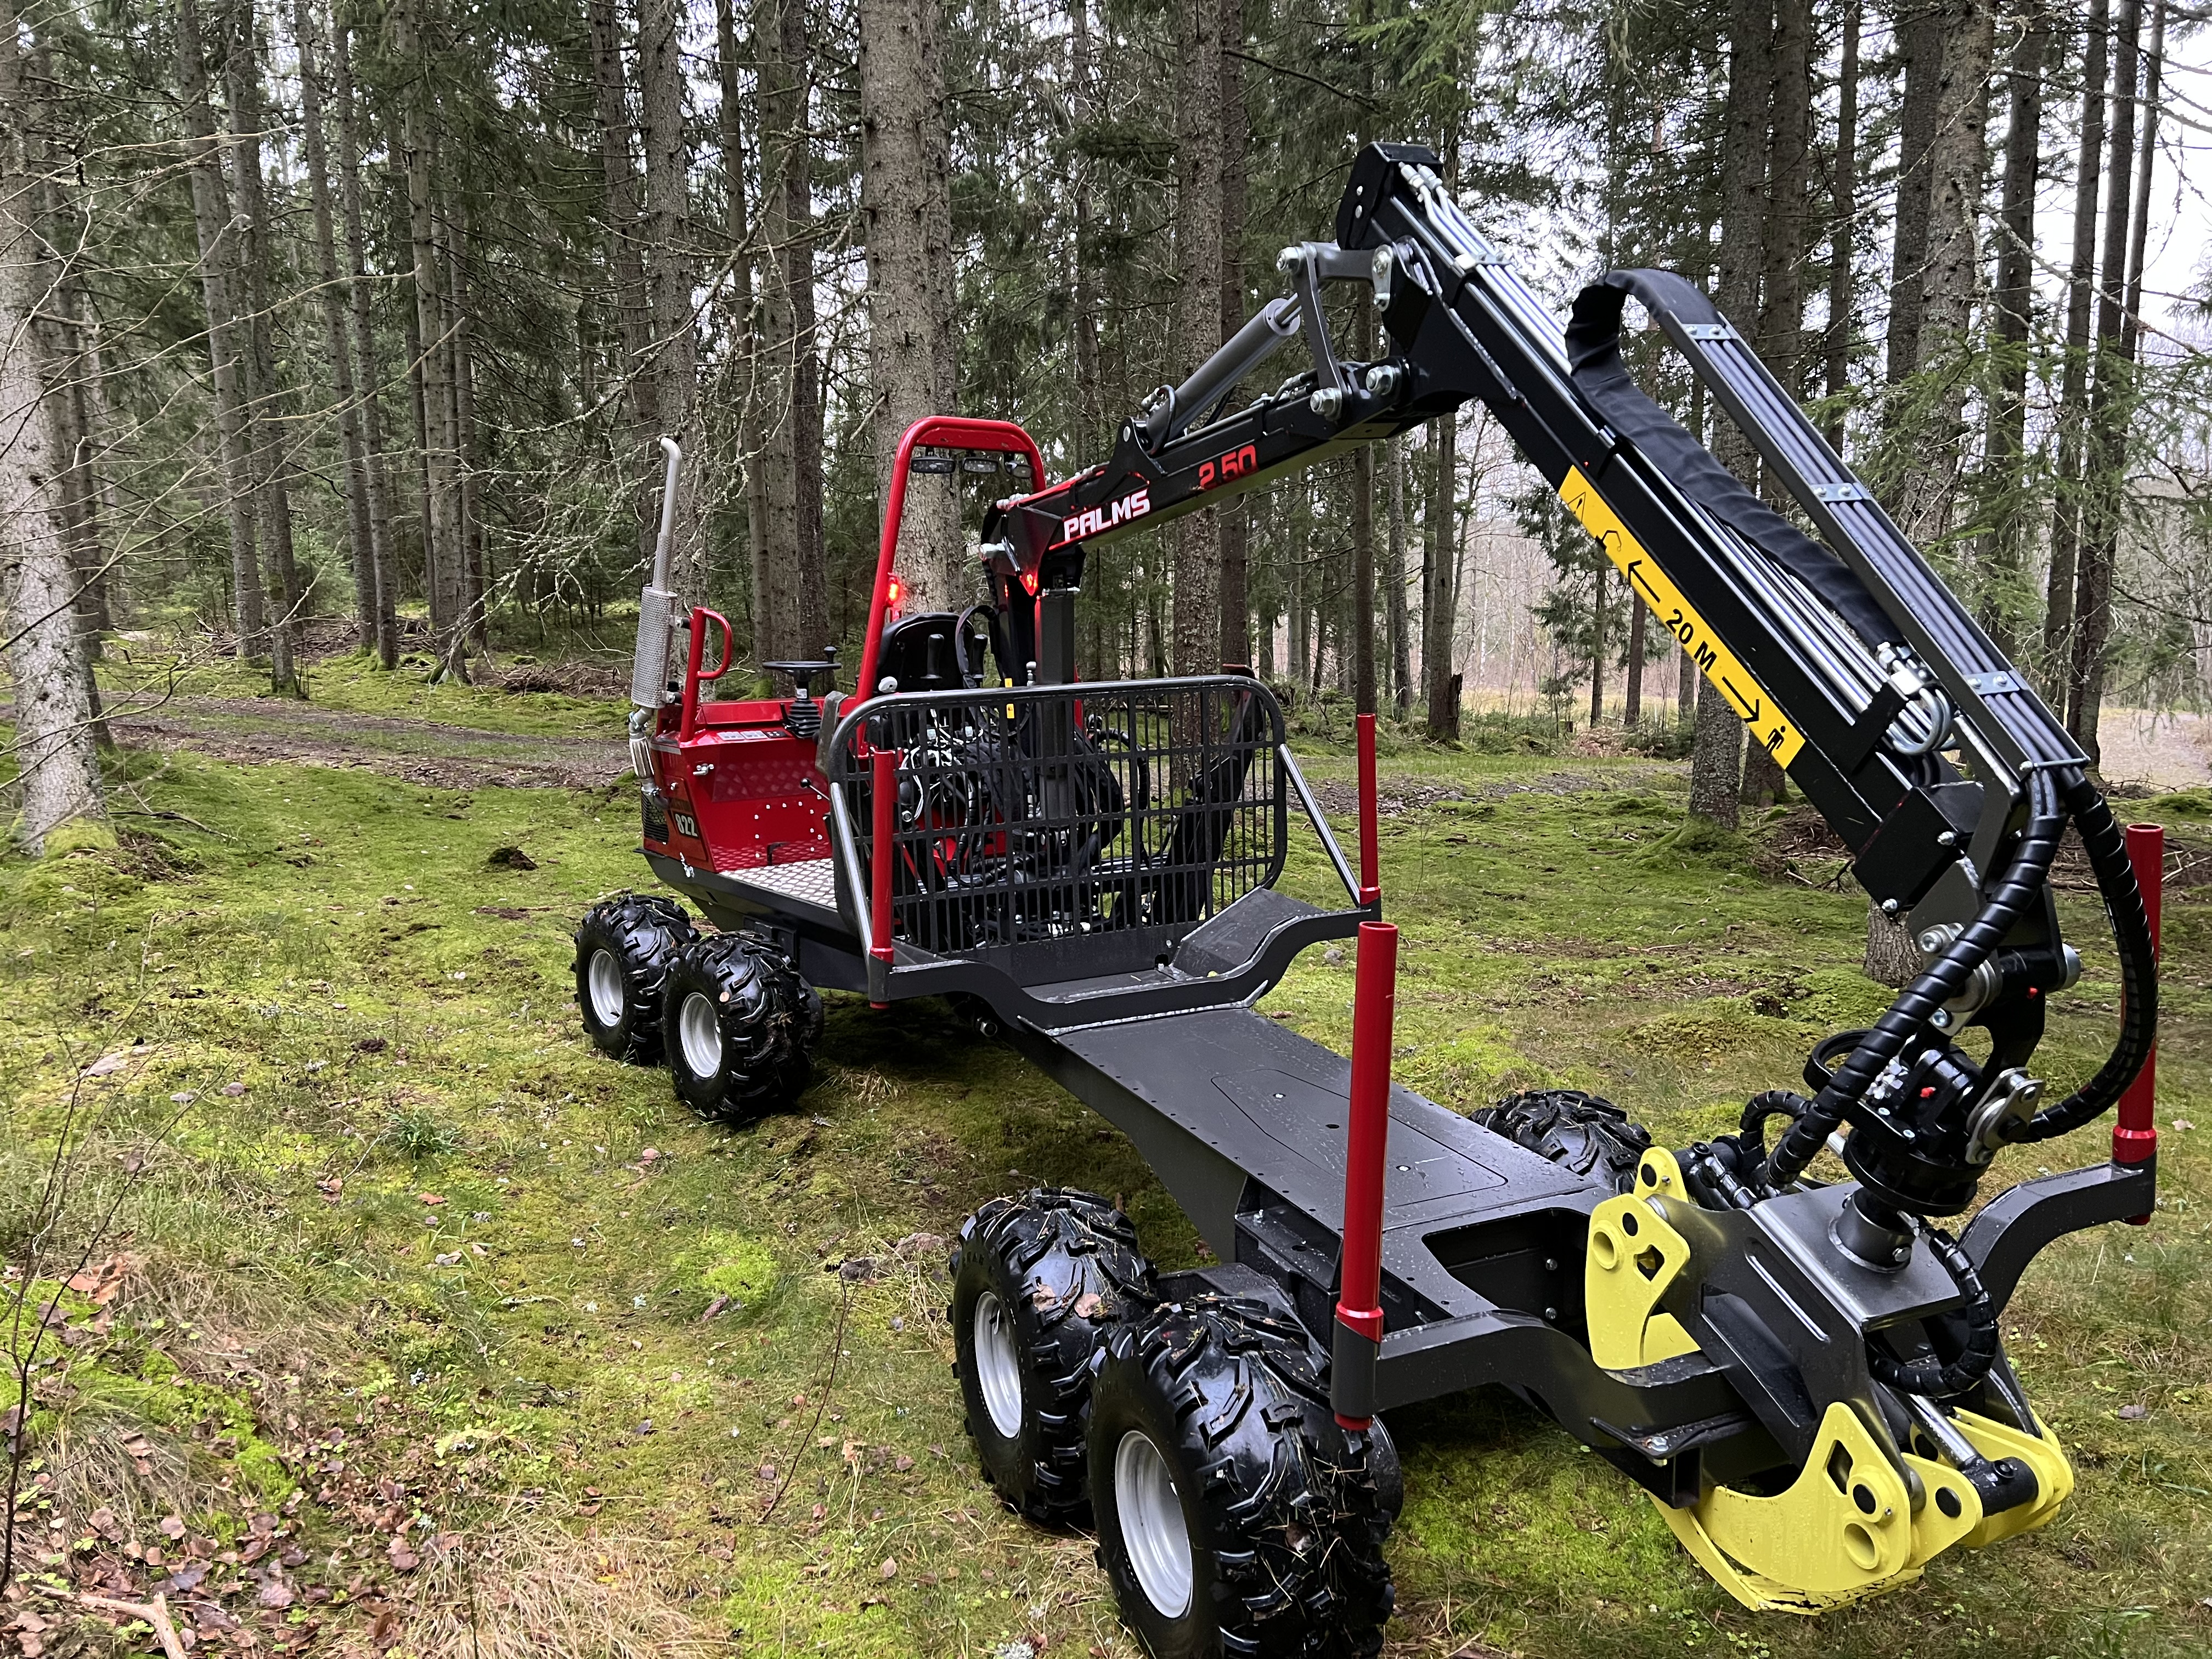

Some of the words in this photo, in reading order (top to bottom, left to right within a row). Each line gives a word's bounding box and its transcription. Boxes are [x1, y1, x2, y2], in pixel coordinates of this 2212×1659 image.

[1064, 489, 1150, 541] PALMS
[1666, 608, 1694, 645] 20
[1694, 640, 1718, 673] M
[675, 814, 698, 837] 822
